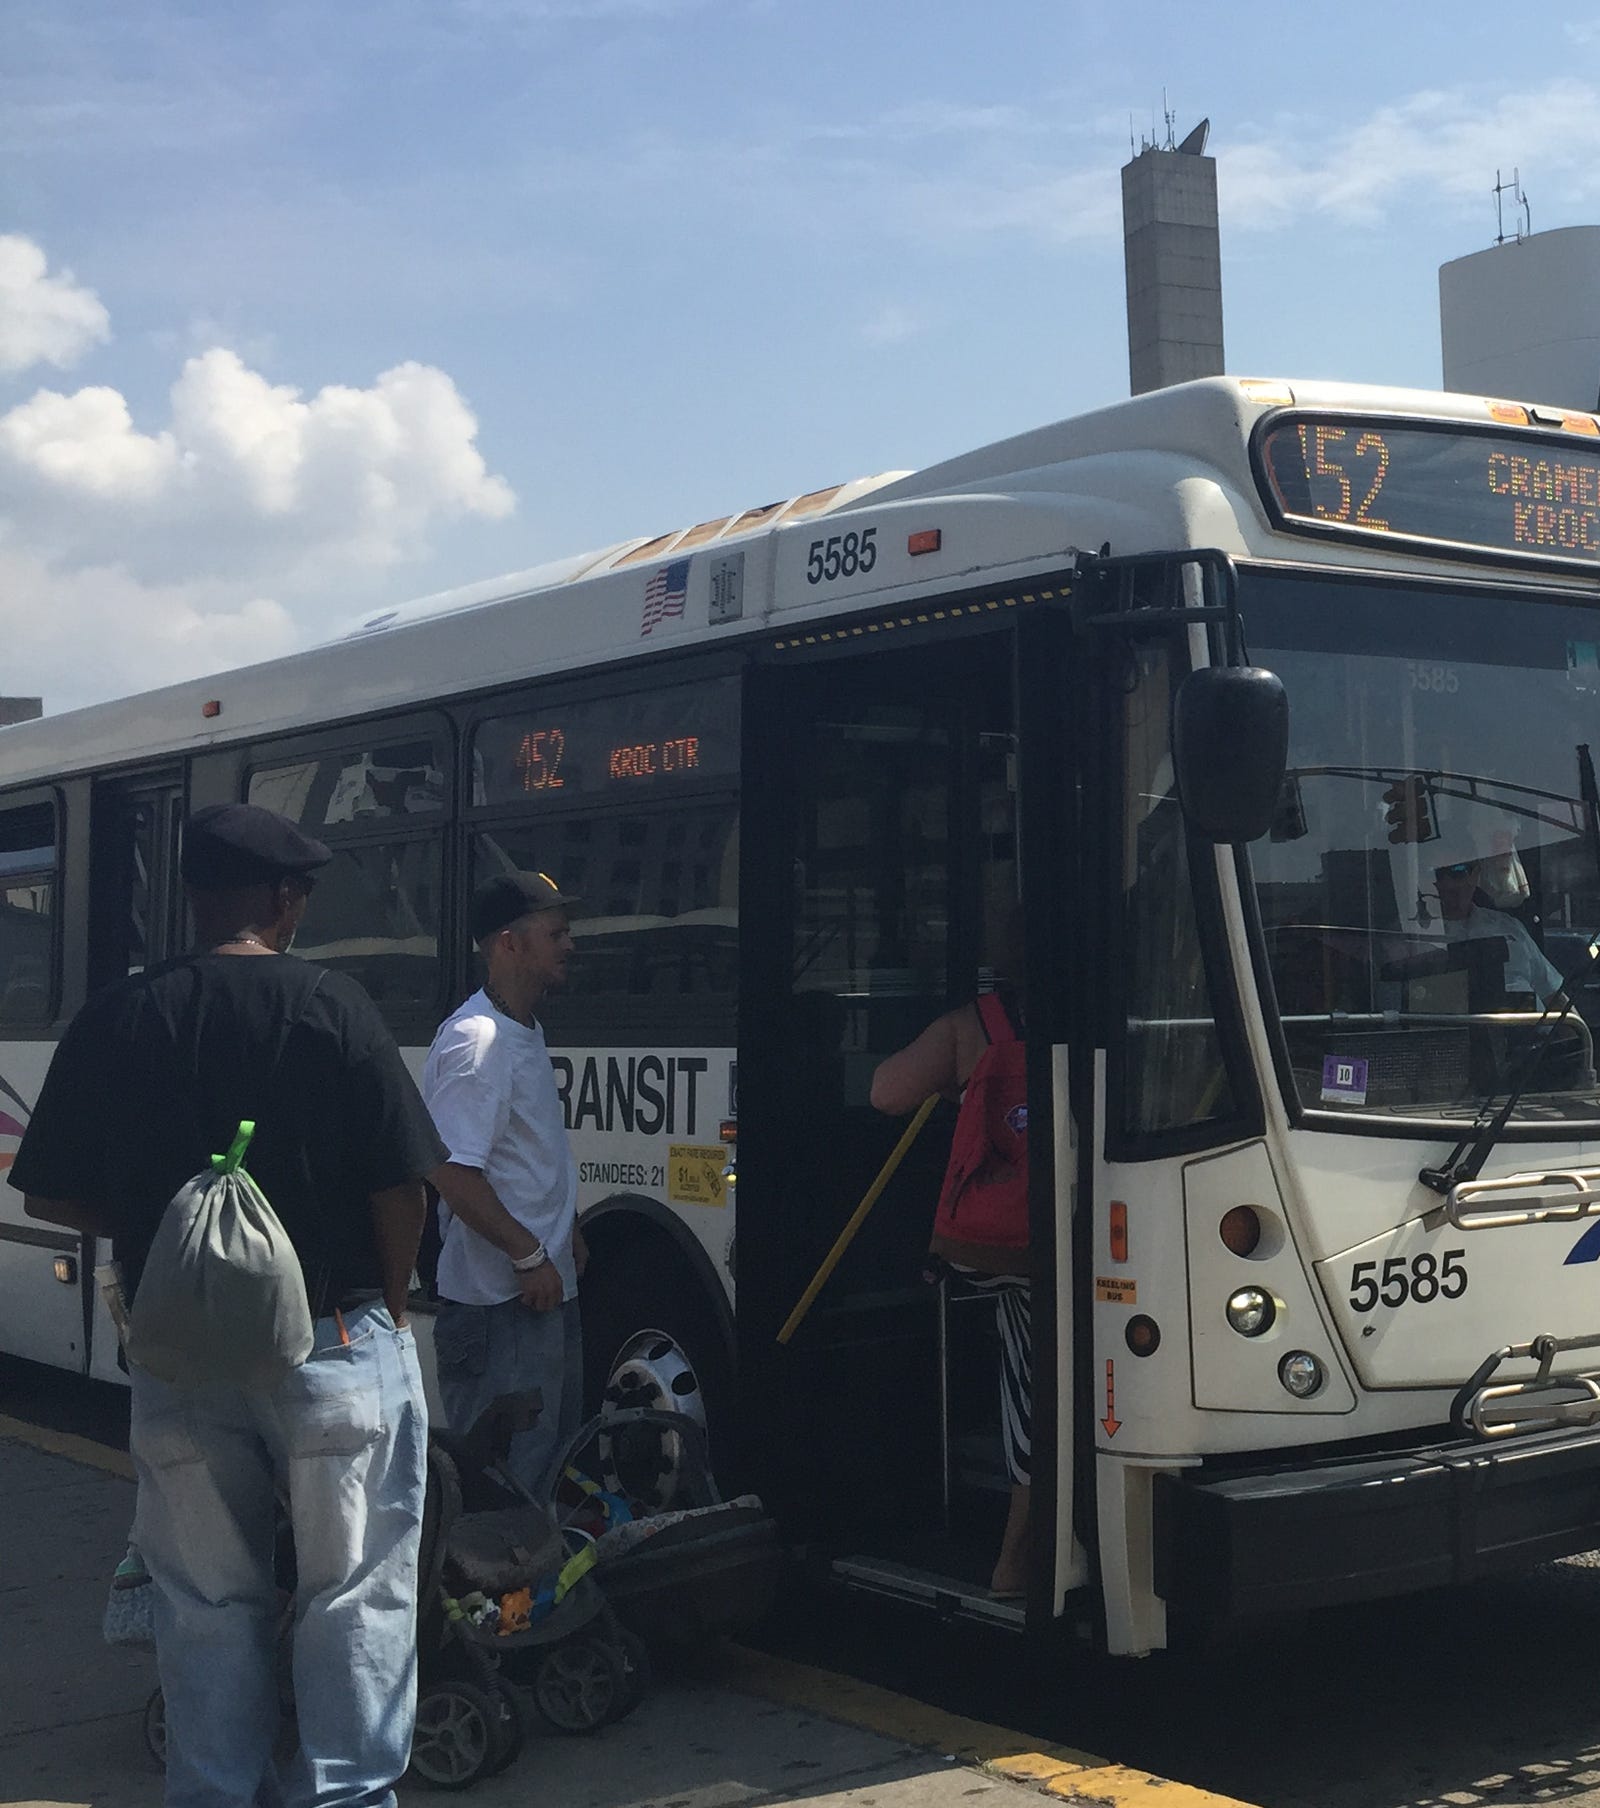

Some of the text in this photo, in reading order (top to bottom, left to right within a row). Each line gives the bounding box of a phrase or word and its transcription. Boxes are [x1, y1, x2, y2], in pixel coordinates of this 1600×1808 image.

[1514, 501, 1600, 550] KROC
[807, 527, 877, 585] 5585
[663, 737, 699, 772] CTR
[1340, 1068, 1350, 1081] 10
[579, 1162, 665, 1187] STANDEES: 21
[1349, 1249, 1468, 1312] 5585
